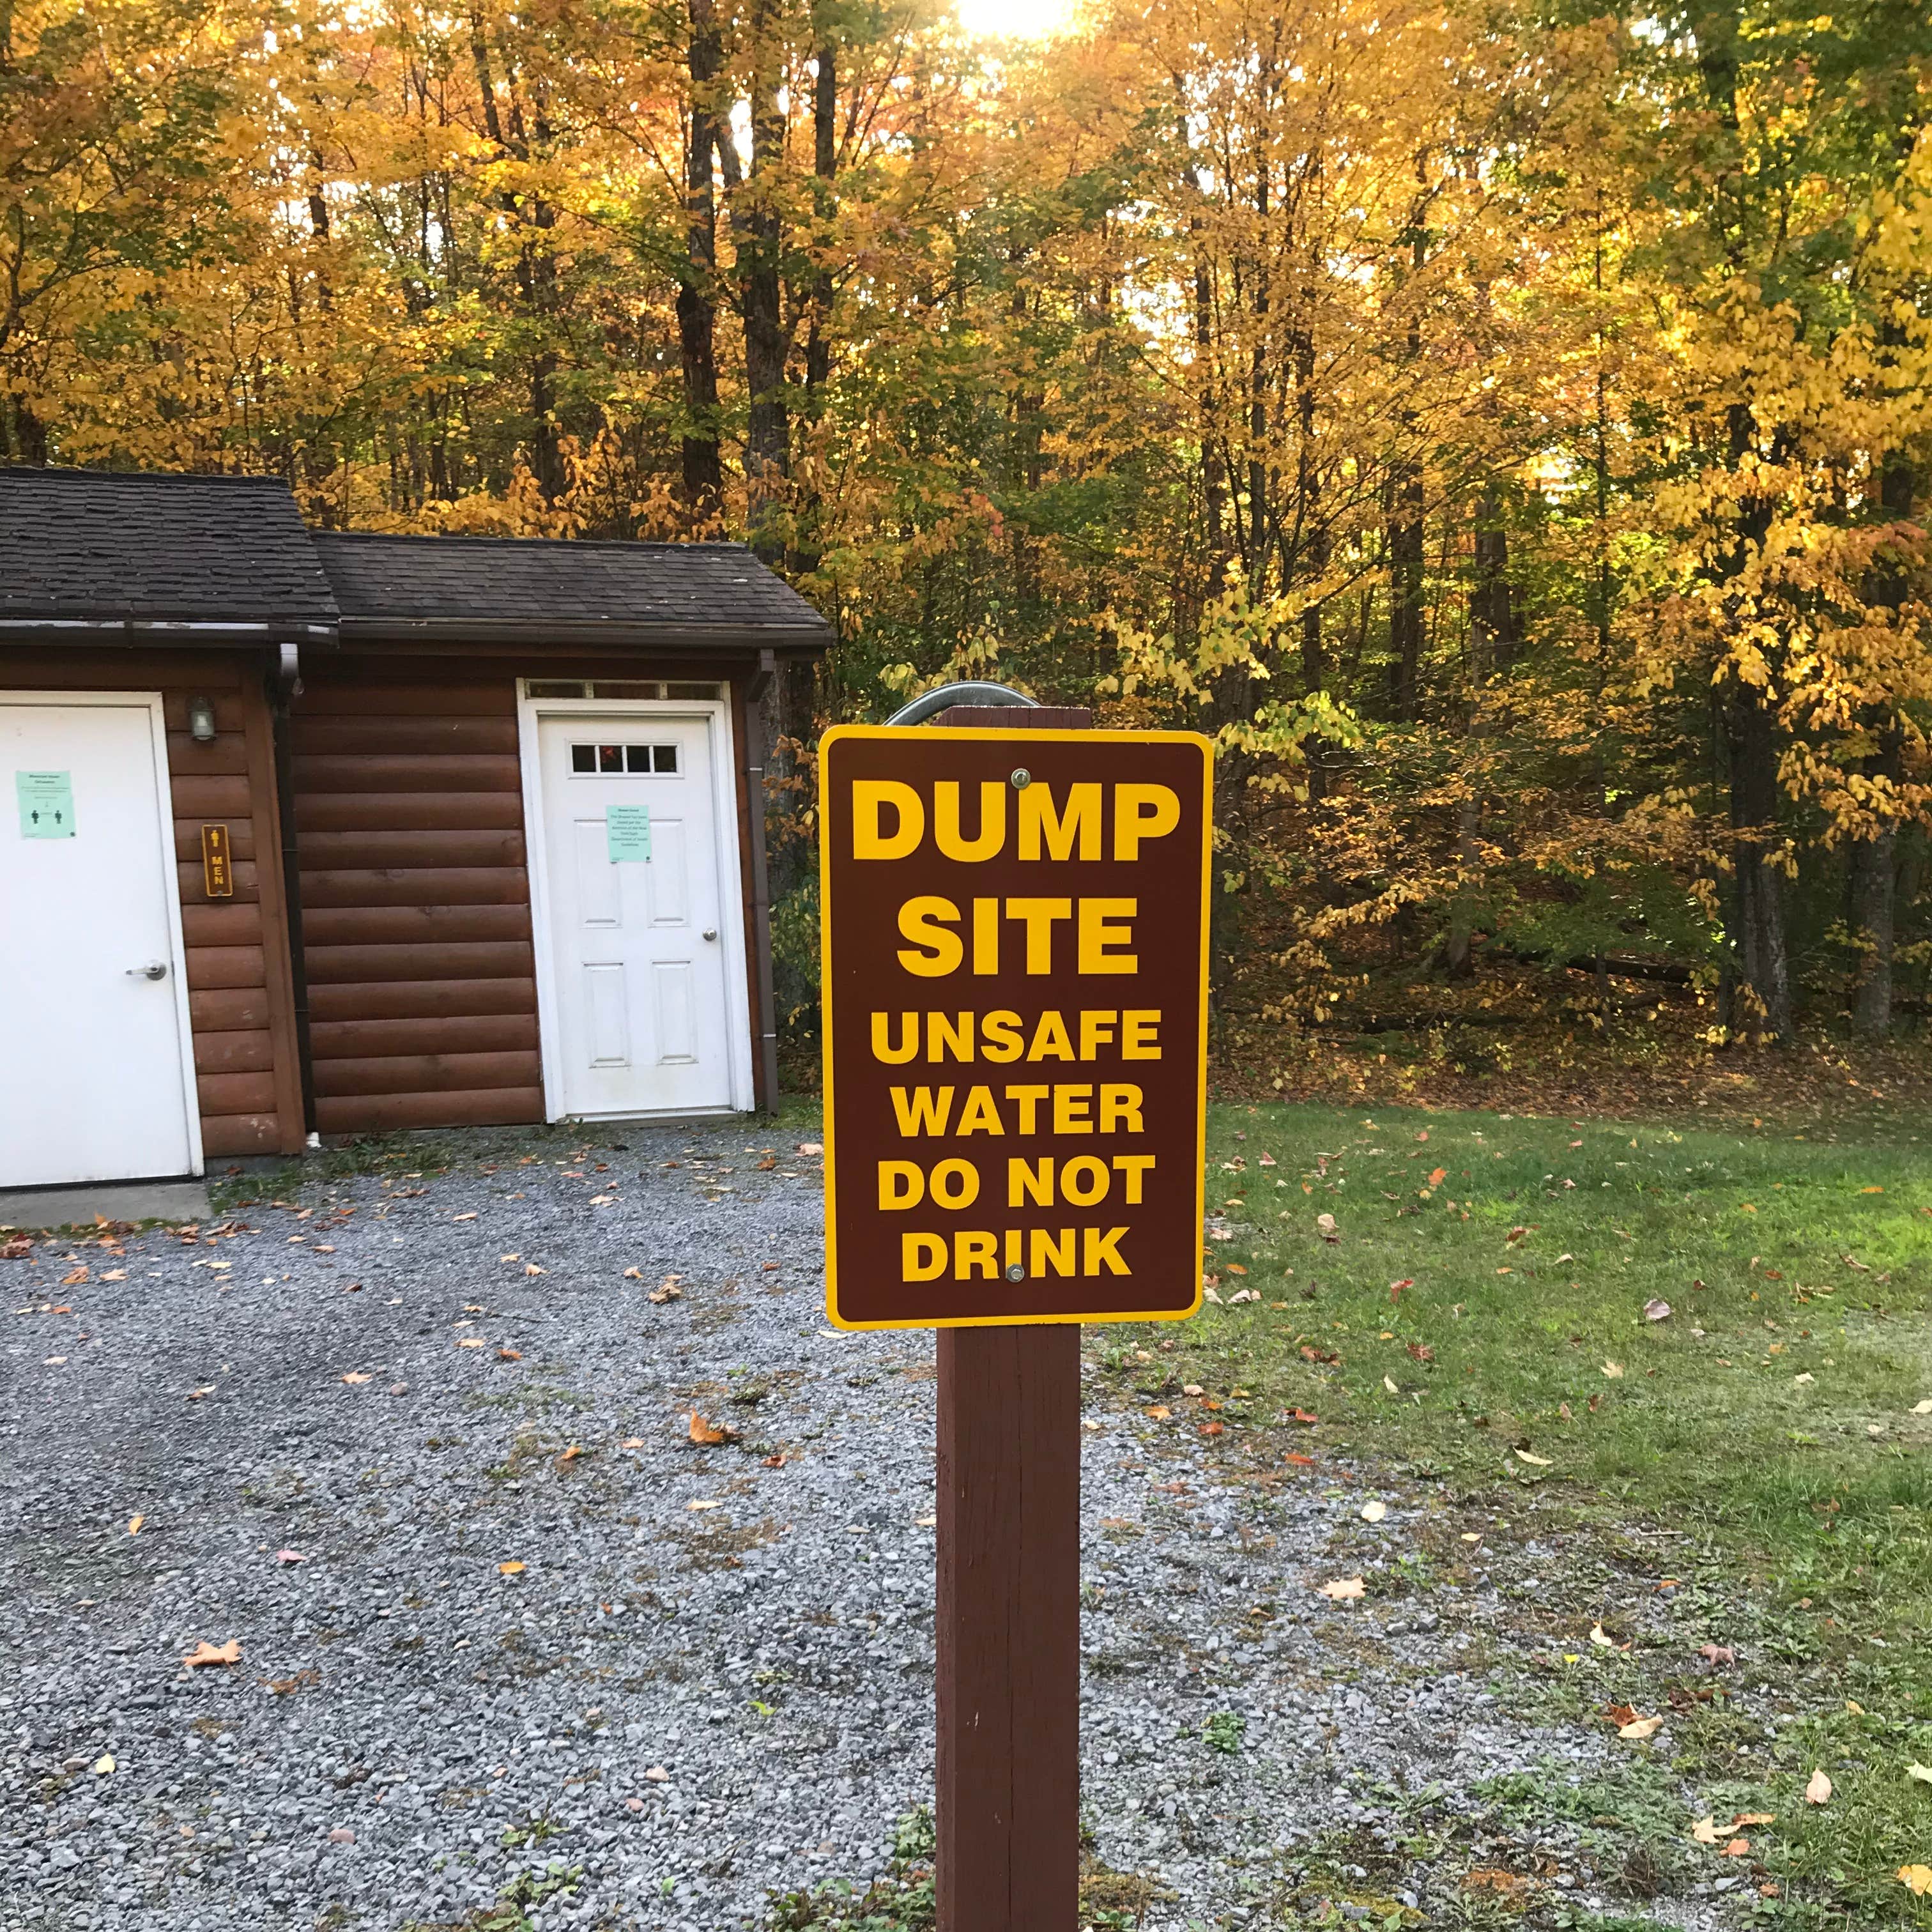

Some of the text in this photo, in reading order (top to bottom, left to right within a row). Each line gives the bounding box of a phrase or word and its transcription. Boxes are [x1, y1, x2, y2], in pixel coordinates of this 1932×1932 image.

[853, 781, 1180, 862] DUMP
[211, 856, 224, 884] MEN
[898, 896, 1137, 977] SITE
[871, 1010, 1161, 1064] UNSAFE
[890, 1084, 1144, 1137] WATER
[878, 1155, 1155, 1210] DO NOT
[902, 1227, 1131, 1282] DRINK
